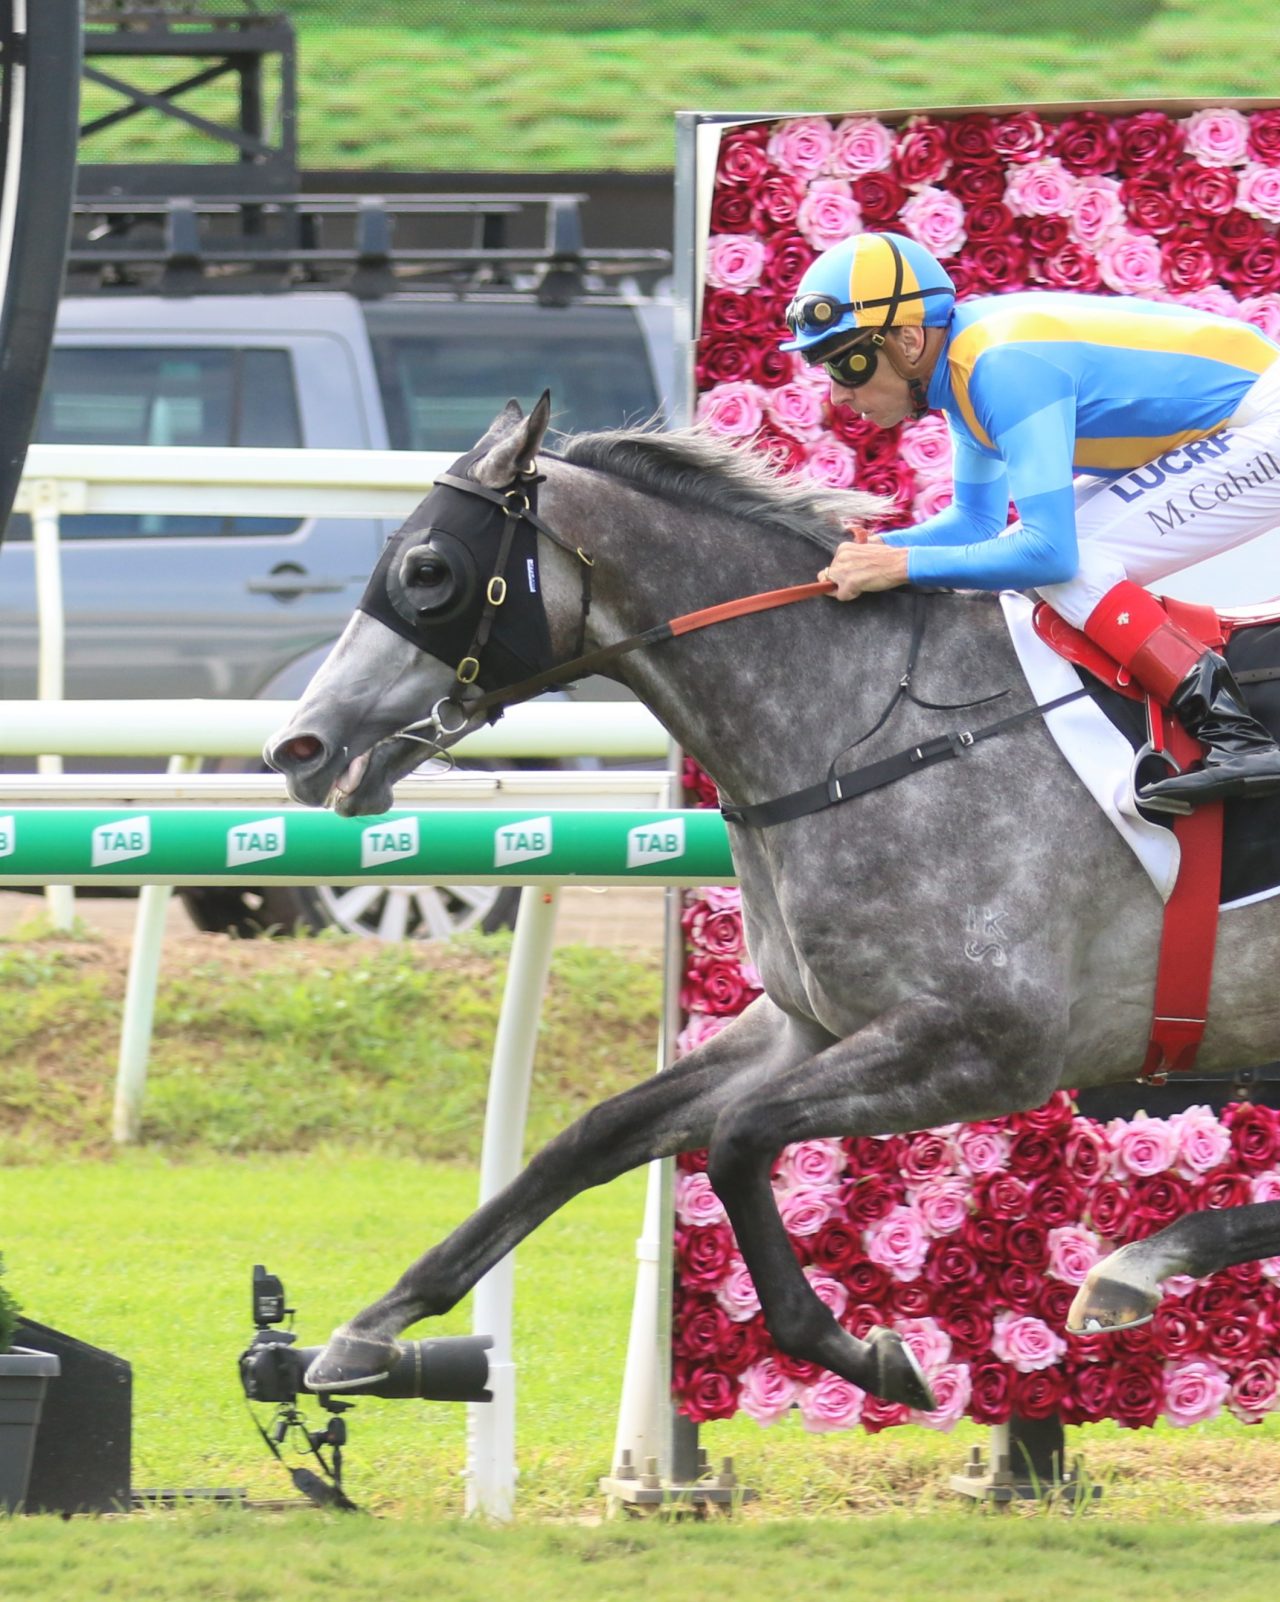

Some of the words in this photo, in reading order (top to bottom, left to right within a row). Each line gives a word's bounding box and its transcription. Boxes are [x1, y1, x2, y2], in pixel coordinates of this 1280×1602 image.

[99, 832, 144, 851] TAB
[234, 832, 278, 852] TAB
[368, 833, 412, 852] TAB
[501, 832, 545, 851] TAB
[634, 833, 678, 853] TAB
